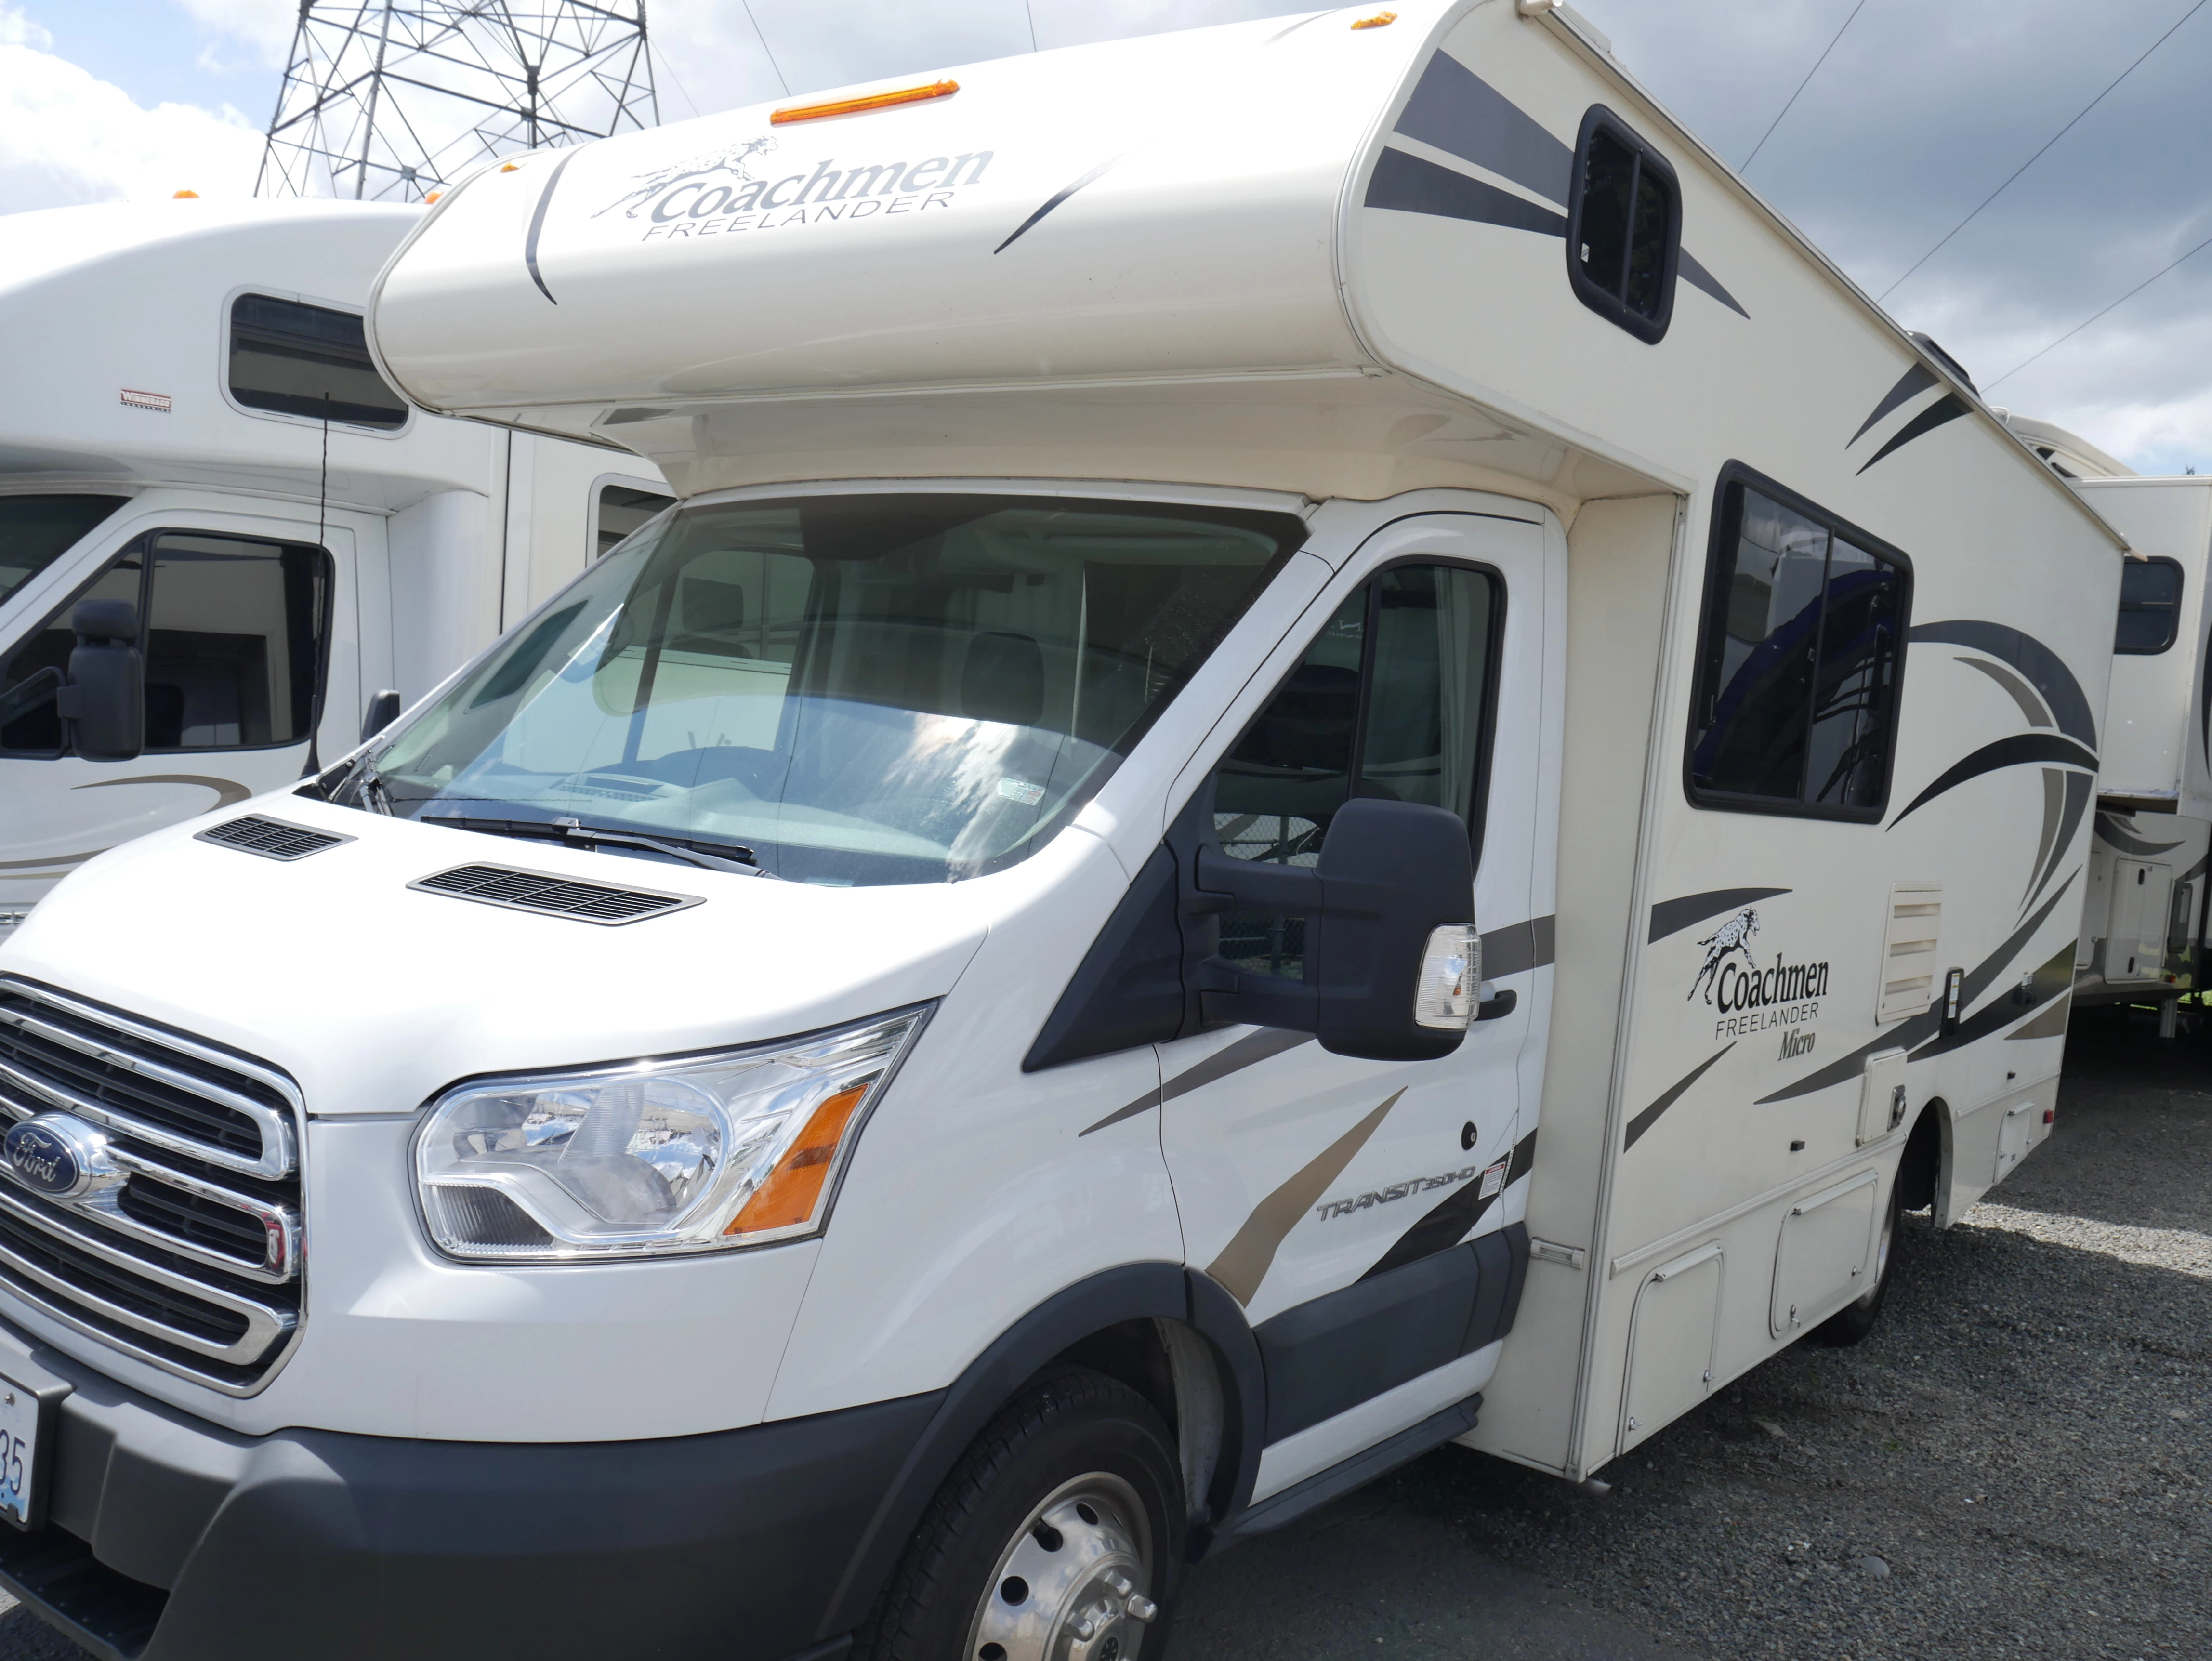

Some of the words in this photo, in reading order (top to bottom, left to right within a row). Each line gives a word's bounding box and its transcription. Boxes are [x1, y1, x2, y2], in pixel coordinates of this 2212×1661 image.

[650, 149, 995, 224] Coachmen
[641, 191, 955, 242] FREELANDER
[1717, 952, 1829, 1014] Coachmen
[1715, 1002, 1819, 1040] FREELANDER
[1778, 1028, 1816, 1061] Micro
[13, 1132, 61, 1182] Ford
[1317, 1176, 1426, 1221] TRANSIT
[0, 1429, 26, 1495] 35
